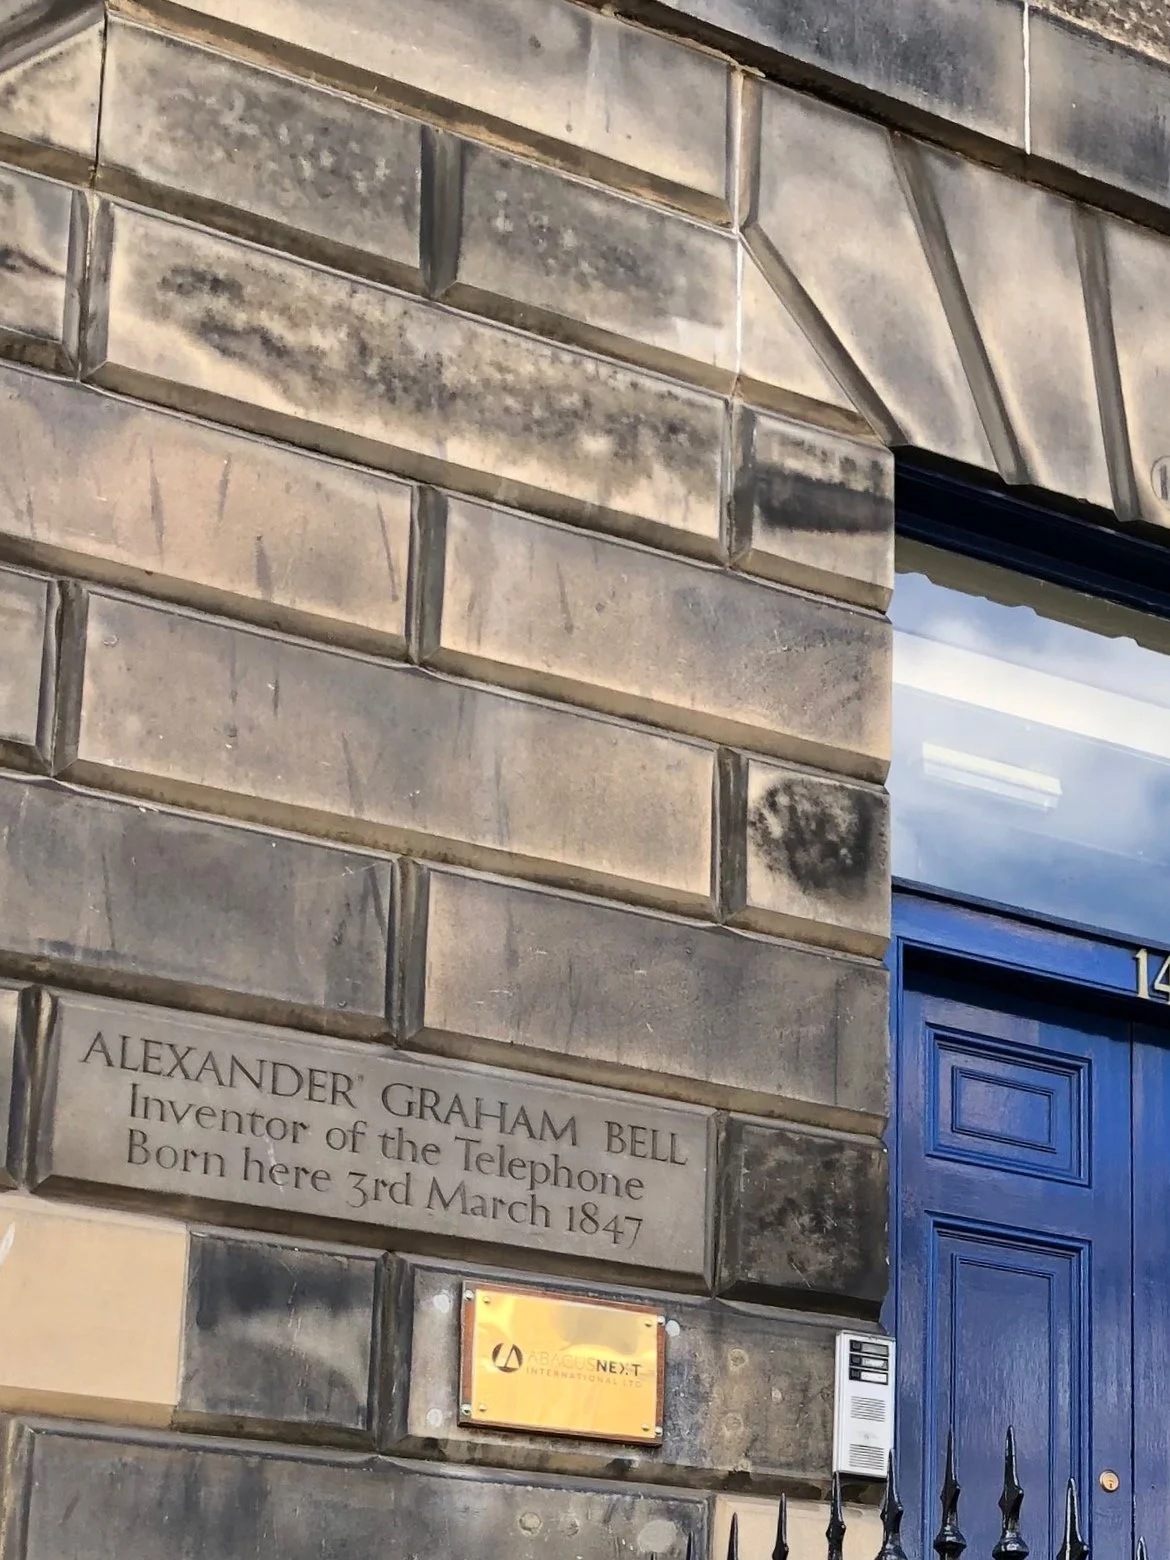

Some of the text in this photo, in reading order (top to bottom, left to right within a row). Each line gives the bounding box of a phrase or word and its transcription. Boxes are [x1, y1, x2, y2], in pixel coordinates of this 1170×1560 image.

[78, 1031, 688, 1166] ALEXANDER GRAHAM BELL
[129, 1083, 645, 1201] Inventor of the Telephone
[127, 1128, 644, 1249] Born here 3rd March 1847
[526, 1366, 617, 1386] INTERNATIONAL
